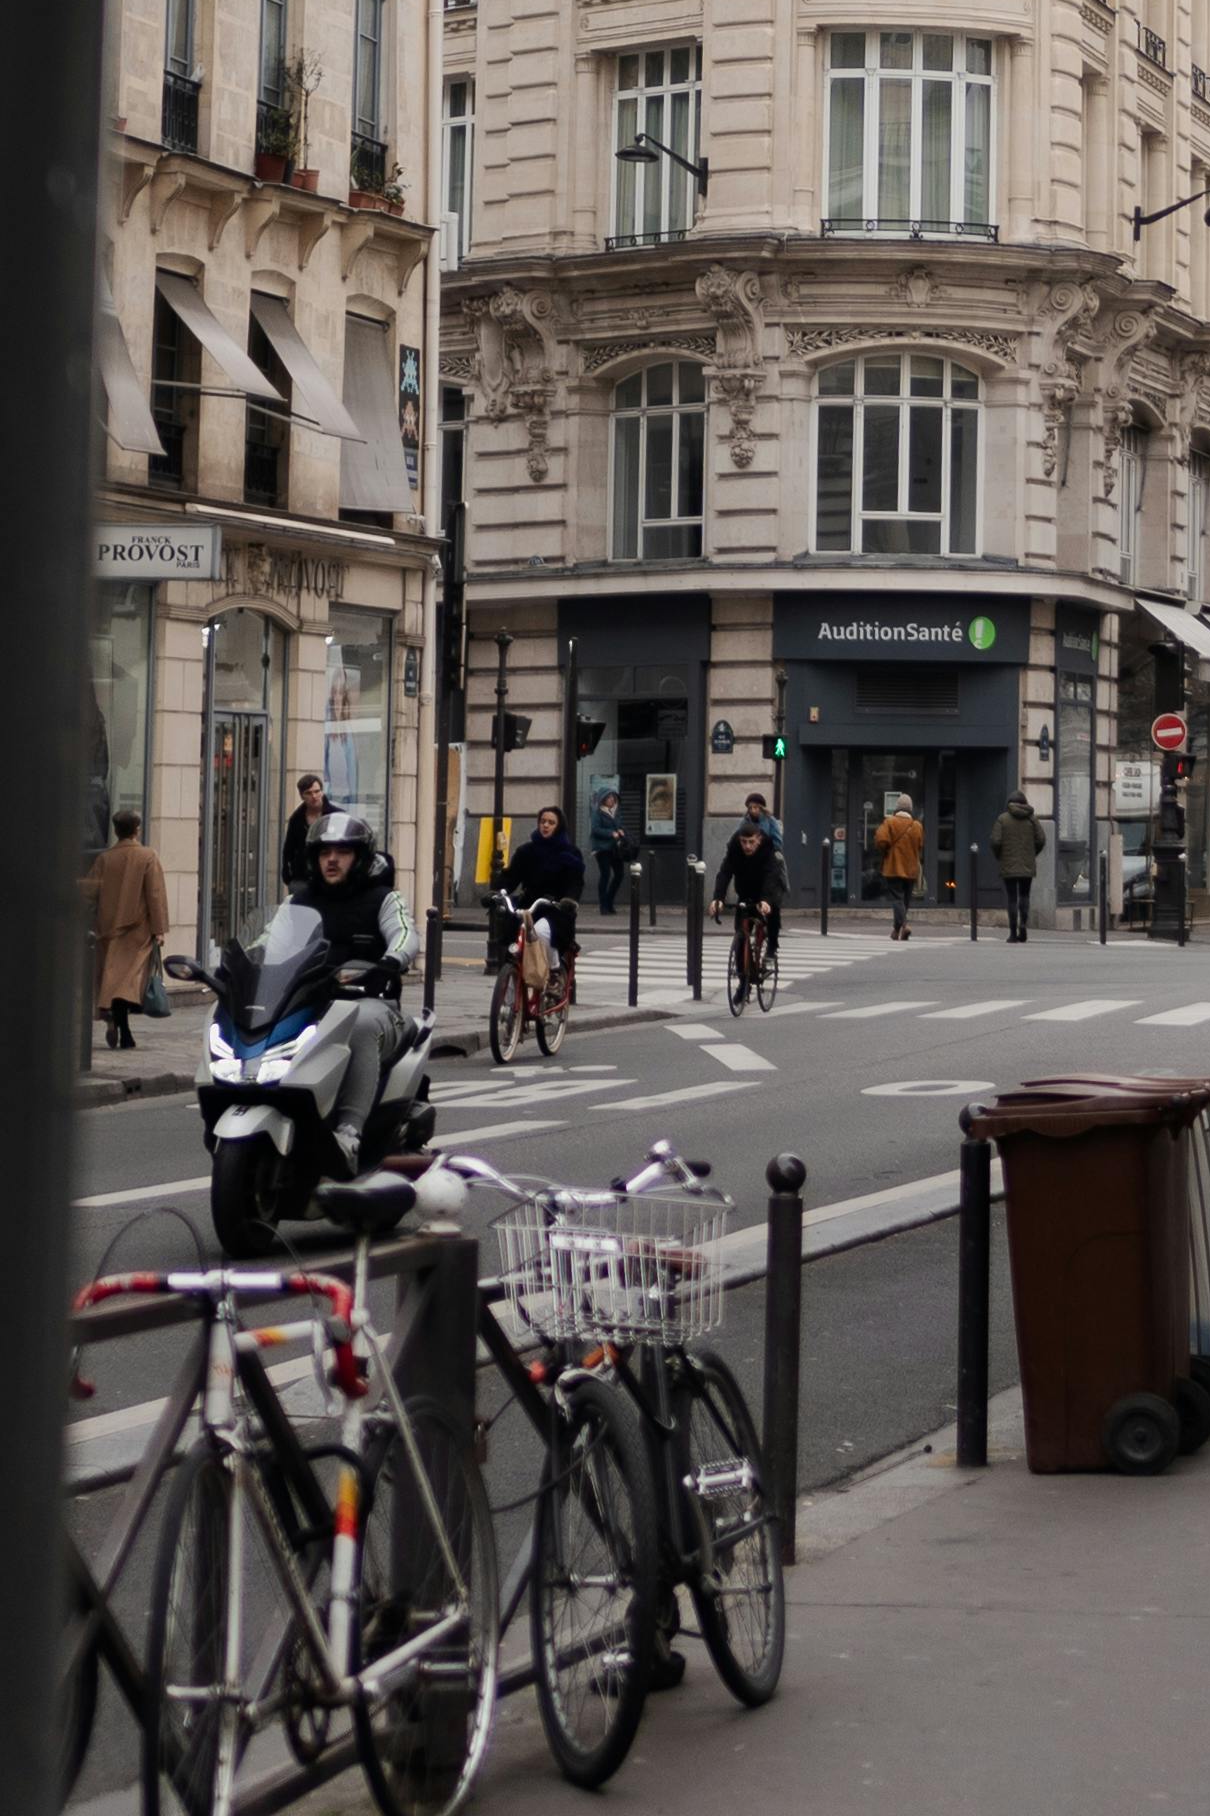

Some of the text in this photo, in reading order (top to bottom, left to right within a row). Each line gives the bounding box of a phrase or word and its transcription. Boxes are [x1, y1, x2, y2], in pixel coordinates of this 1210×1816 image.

[131, 536, 171, 544] FRANCK
[98, 544, 204, 561] PROVOST
[817, 621, 963, 642] AuditionSanté
